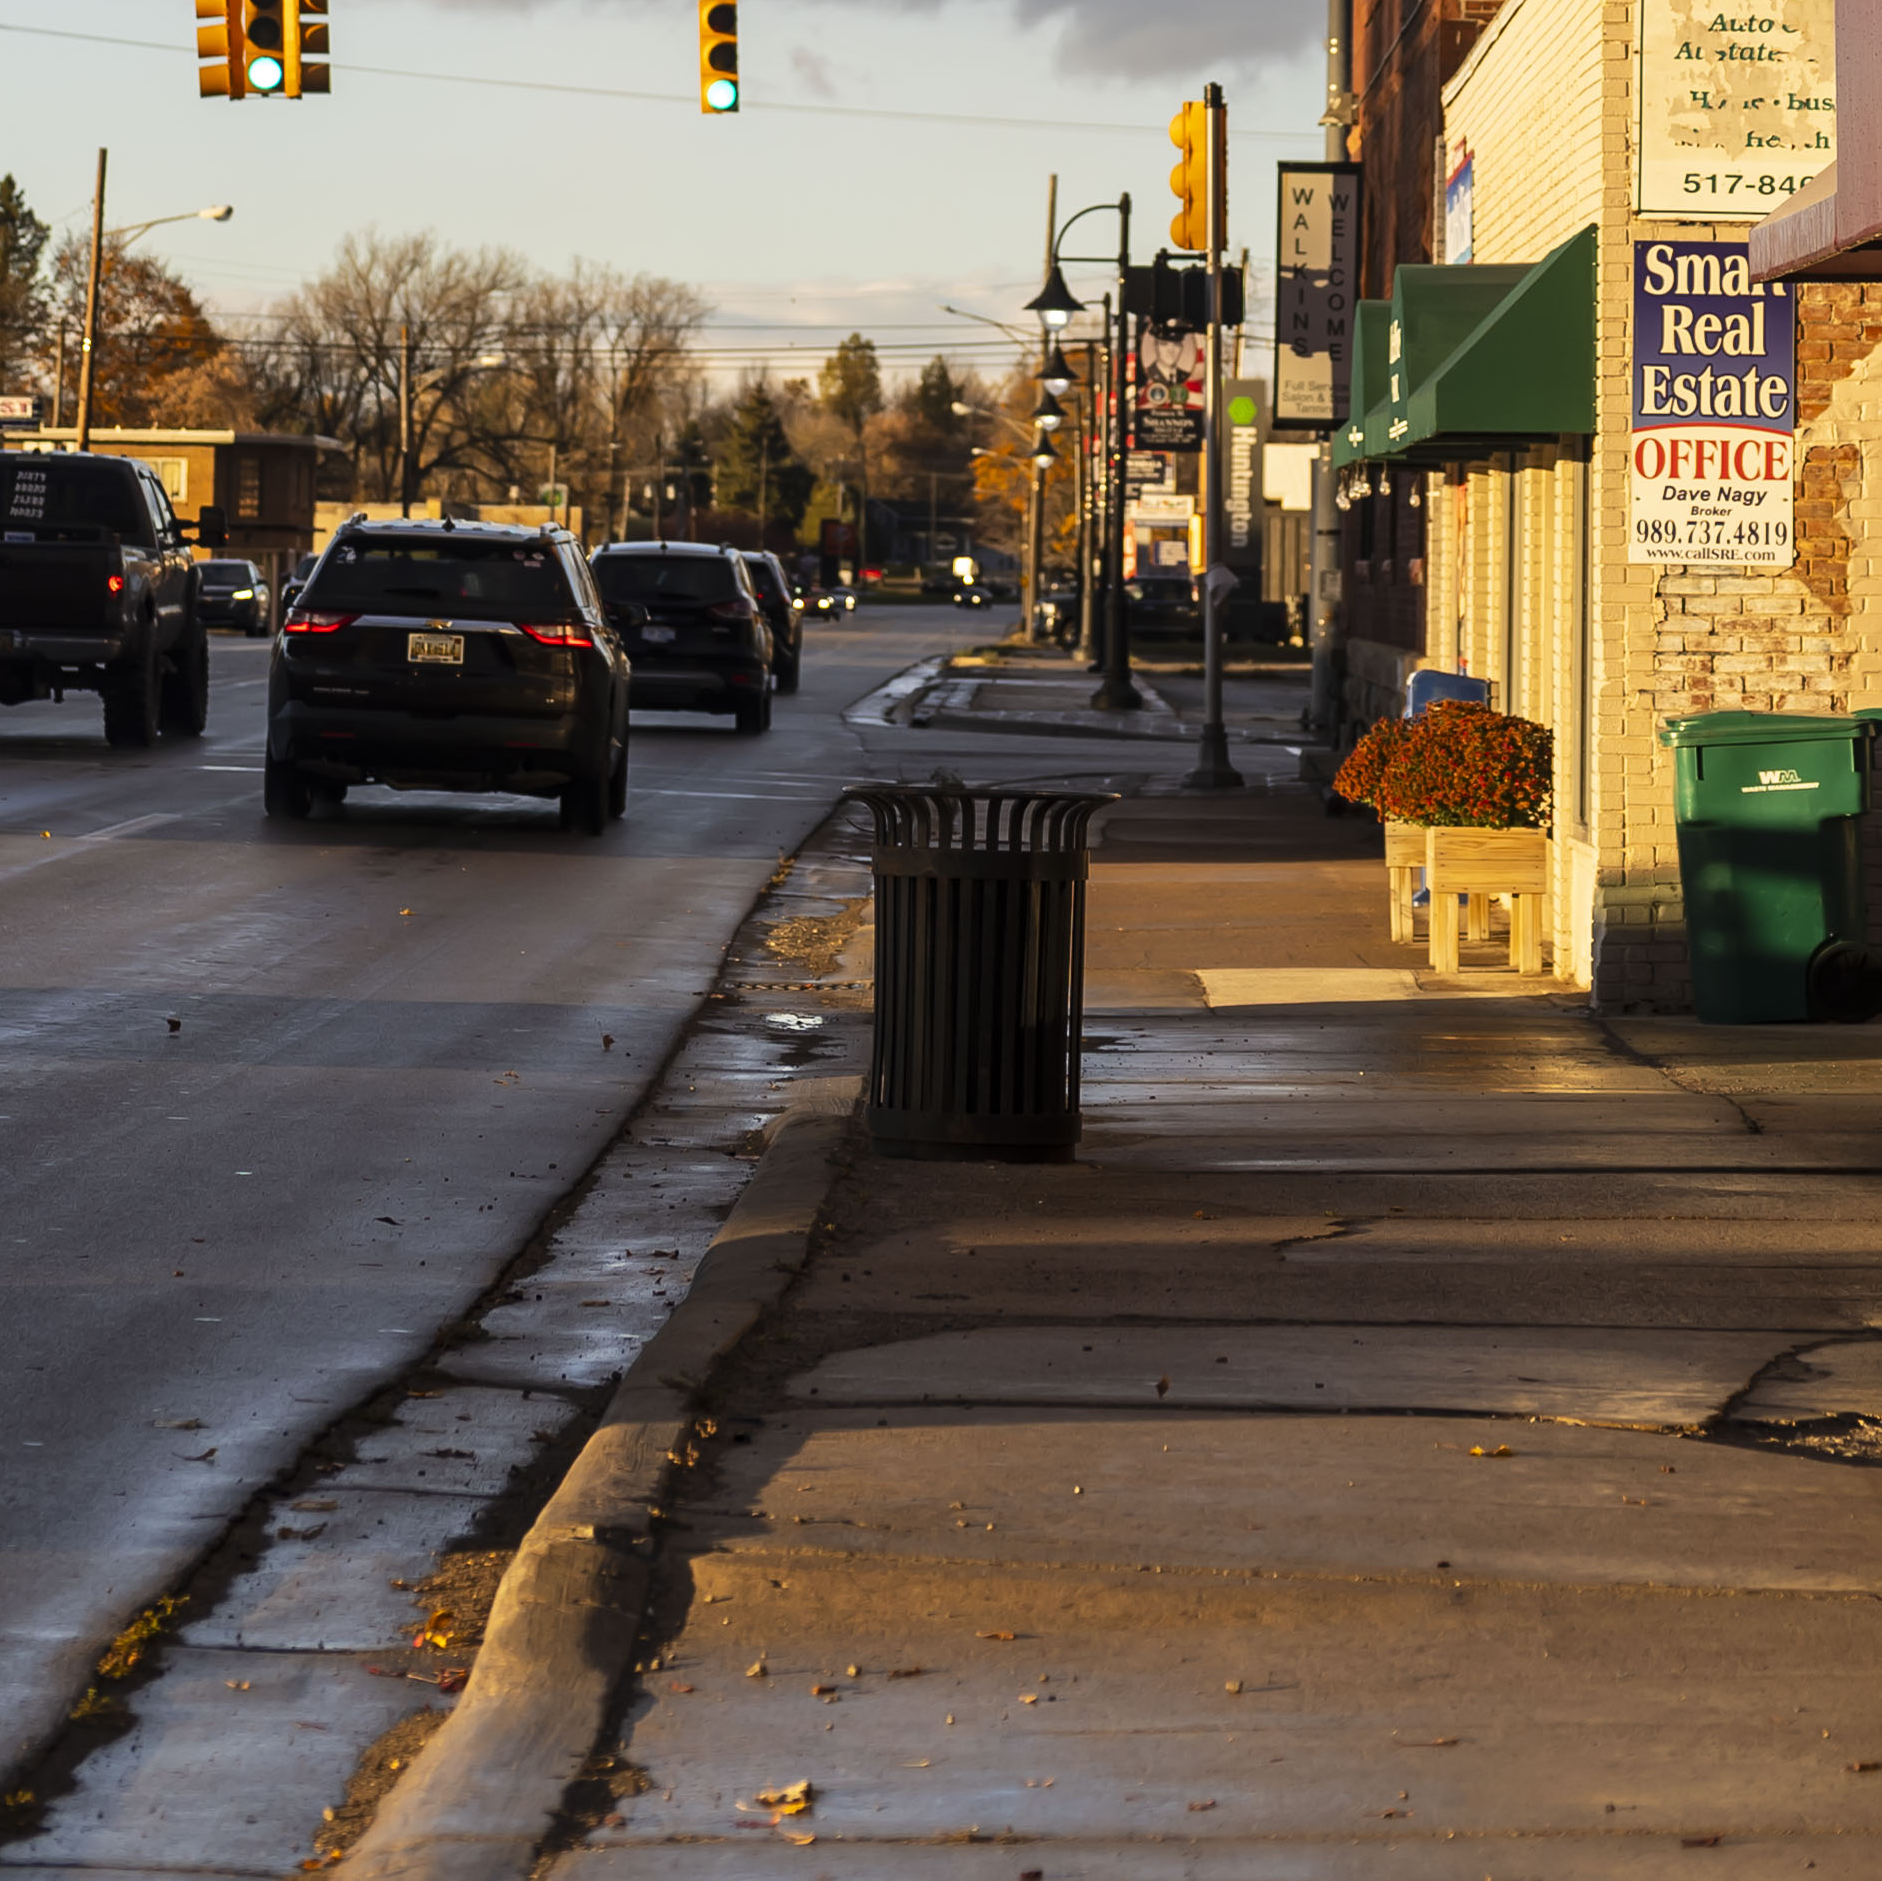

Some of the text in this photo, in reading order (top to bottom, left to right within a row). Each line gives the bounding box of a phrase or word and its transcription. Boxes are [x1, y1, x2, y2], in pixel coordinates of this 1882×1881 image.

[1660, 301, 1766, 356] Real
[1639, 364, 1788, 418] Estate
[1635, 437, 1790, 481] OFFICE
[1225, 426, 1257, 547] Huntington
[1662, 485, 1767, 506] Dave Nagy
[1691, 506, 1732, 517] Broker
[1636, 519, 1788, 546] 989.737.4819
[1646, 547, 1775, 562] www.callSRE.com
[1759, 769, 1802, 784] WM
